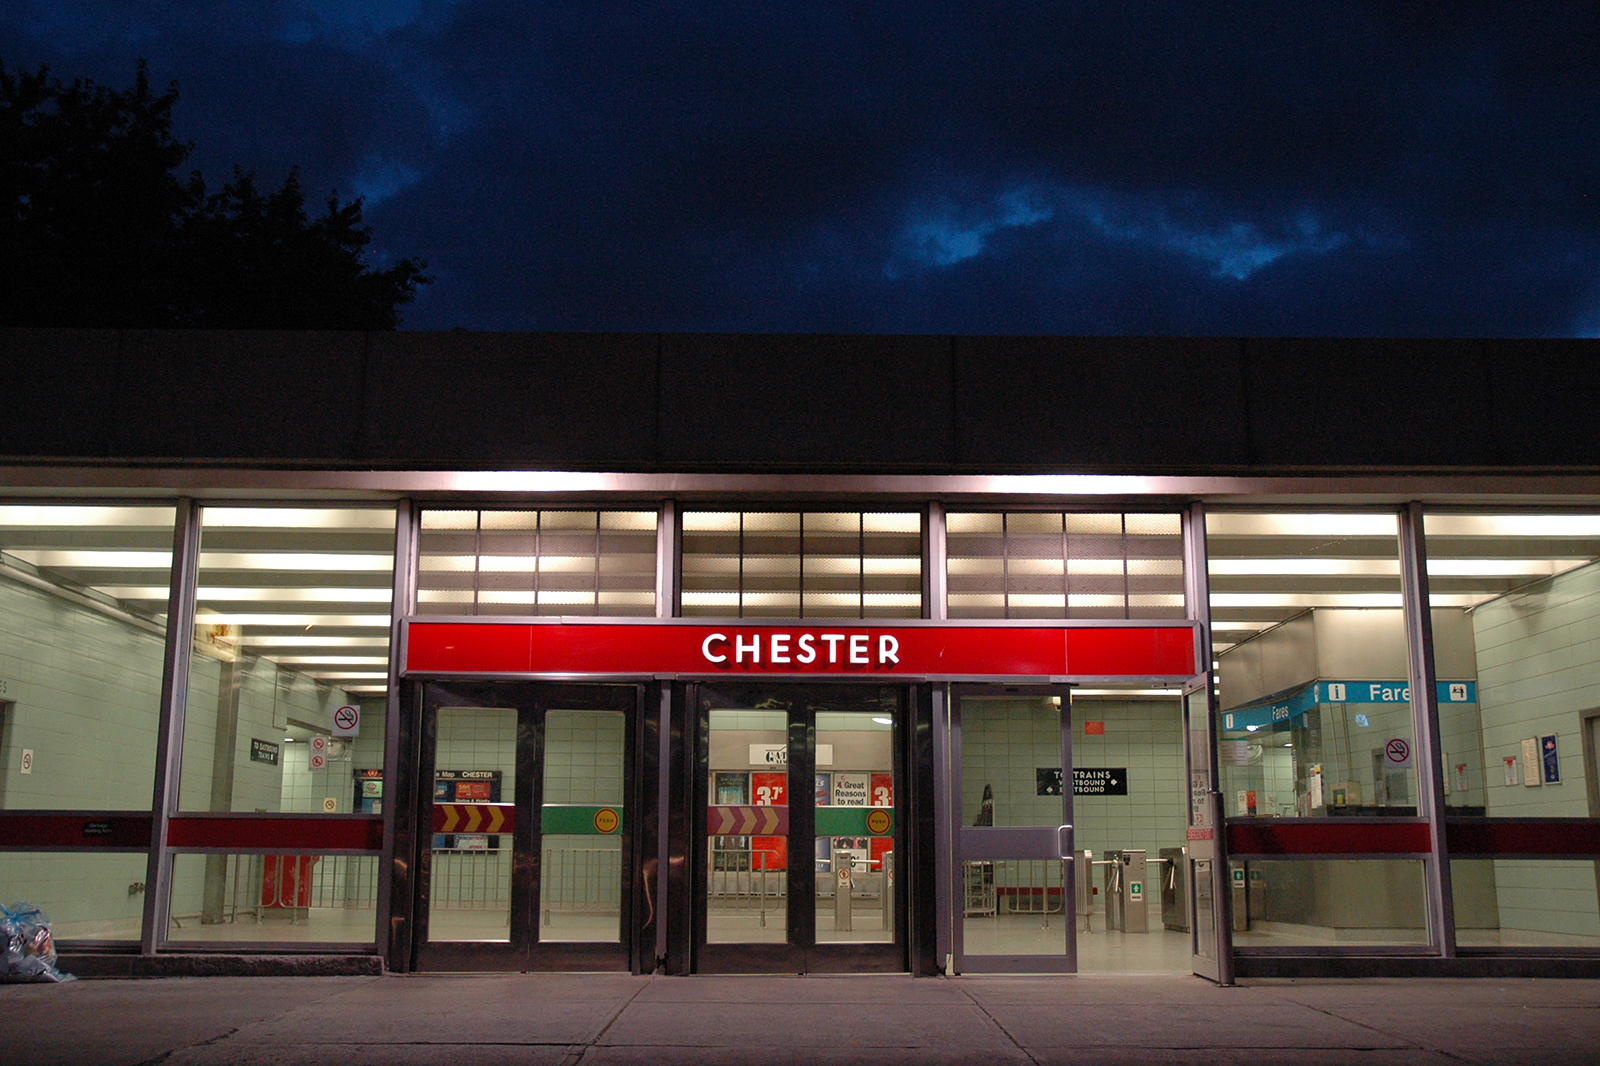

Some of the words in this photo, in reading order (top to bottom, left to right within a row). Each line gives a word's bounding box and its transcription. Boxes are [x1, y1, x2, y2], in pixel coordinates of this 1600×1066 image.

[701, 633, 900, 664] CHESTER
[1369, 684, 1410, 701] Fare
[1272, 705, 1289, 720] Fares
[1073, 771, 1111, 779] TRAINS
